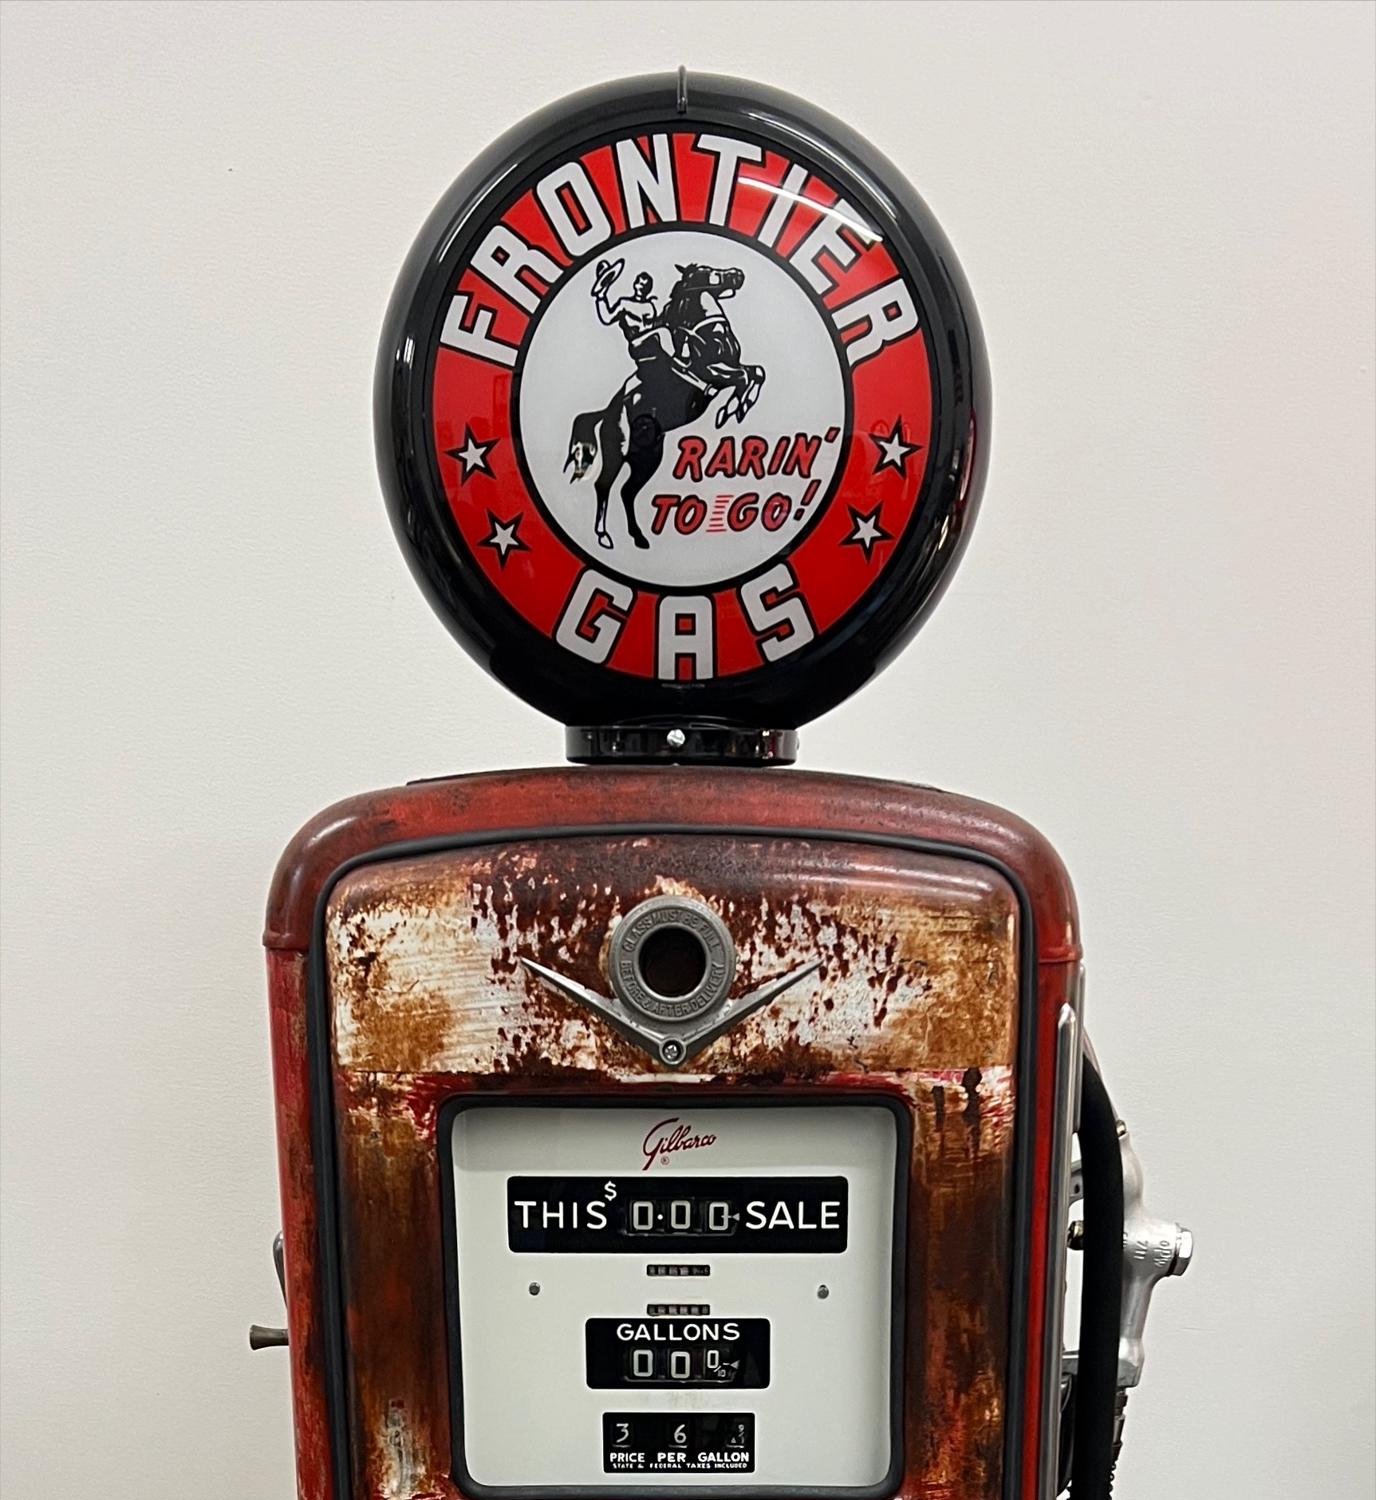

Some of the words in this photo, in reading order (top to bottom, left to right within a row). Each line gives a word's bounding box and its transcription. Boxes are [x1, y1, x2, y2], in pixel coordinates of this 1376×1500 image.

[440, 134, 919, 367] FRONTIER
[673, 427, 840, 480] RARIN'
[651, 495, 704, 535] TO
[727, 479, 821, 533] GO!
[555, 563, 815, 681] GAS
[642, 1117, 717, 1171] Gilbarco
[514, 1201, 607, 1229] THIS
[745, 1201, 840, 1229] SALE
[616, 1323, 740, 1341] GALLONS
[610, 1452, 645, 1462] PRICE
[657, 1452, 687, 1462] PER
[698, 1452, 749, 1462] GALLON
